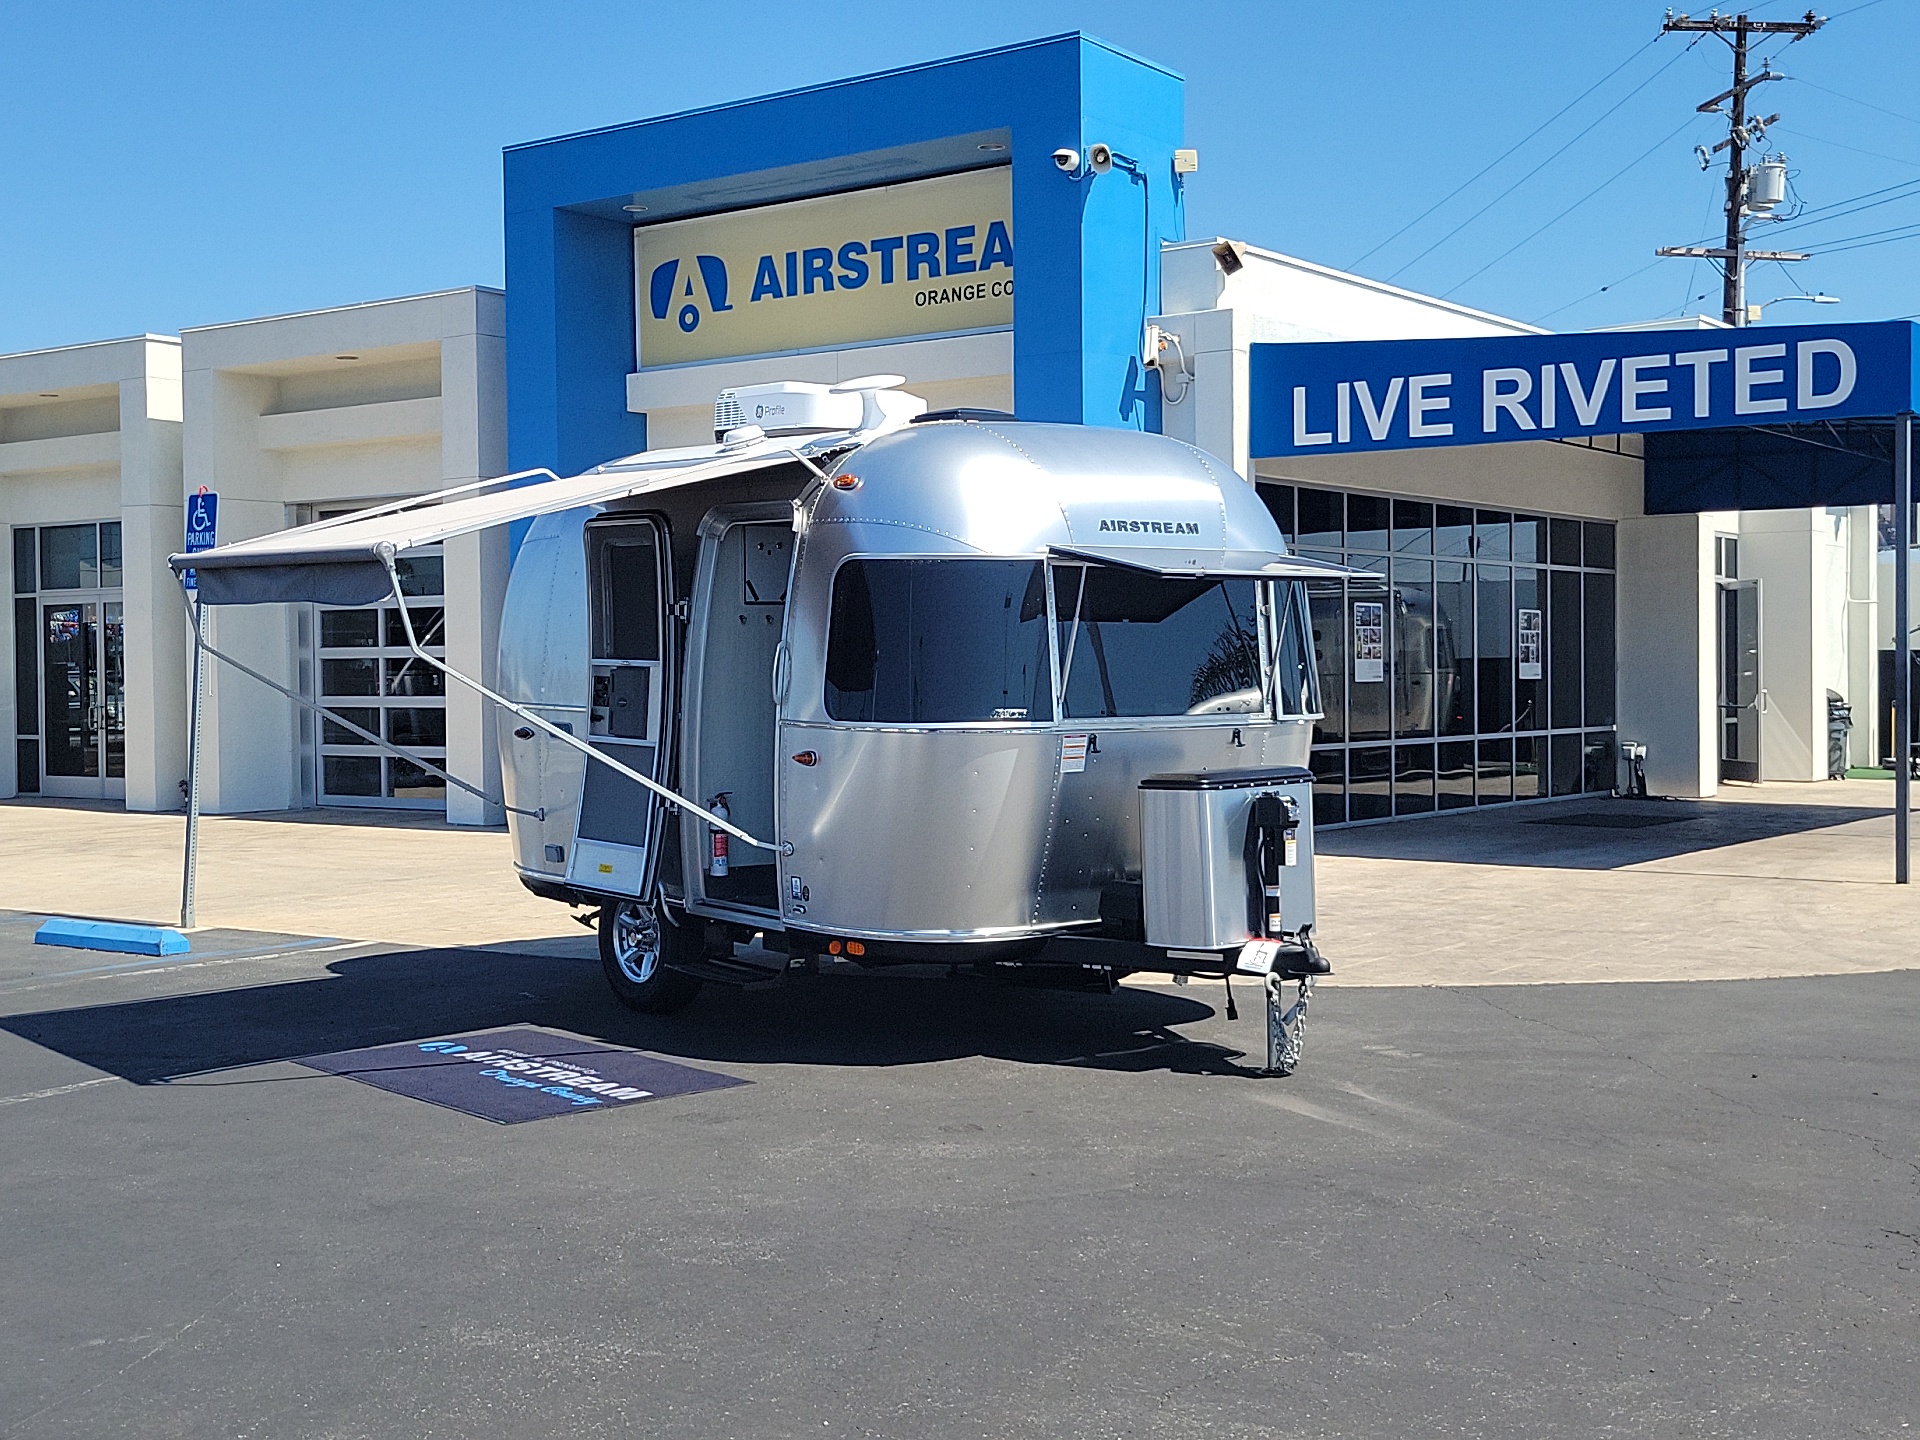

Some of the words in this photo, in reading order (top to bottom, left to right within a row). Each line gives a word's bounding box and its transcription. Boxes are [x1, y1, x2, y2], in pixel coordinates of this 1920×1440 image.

[915, 283, 986, 307] ORANGE
[1293, 372, 1454, 447] LIVE
[1482, 338, 1857, 433] RIVETED
[764, 405, 785, 416] Profile
[1098, 519, 1200, 535] AIRSTREAM
[187, 531, 215, 546] PARKING
[186, 577, 197, 587] FINE
[452, 1050, 654, 1101] AIRSTREAM
